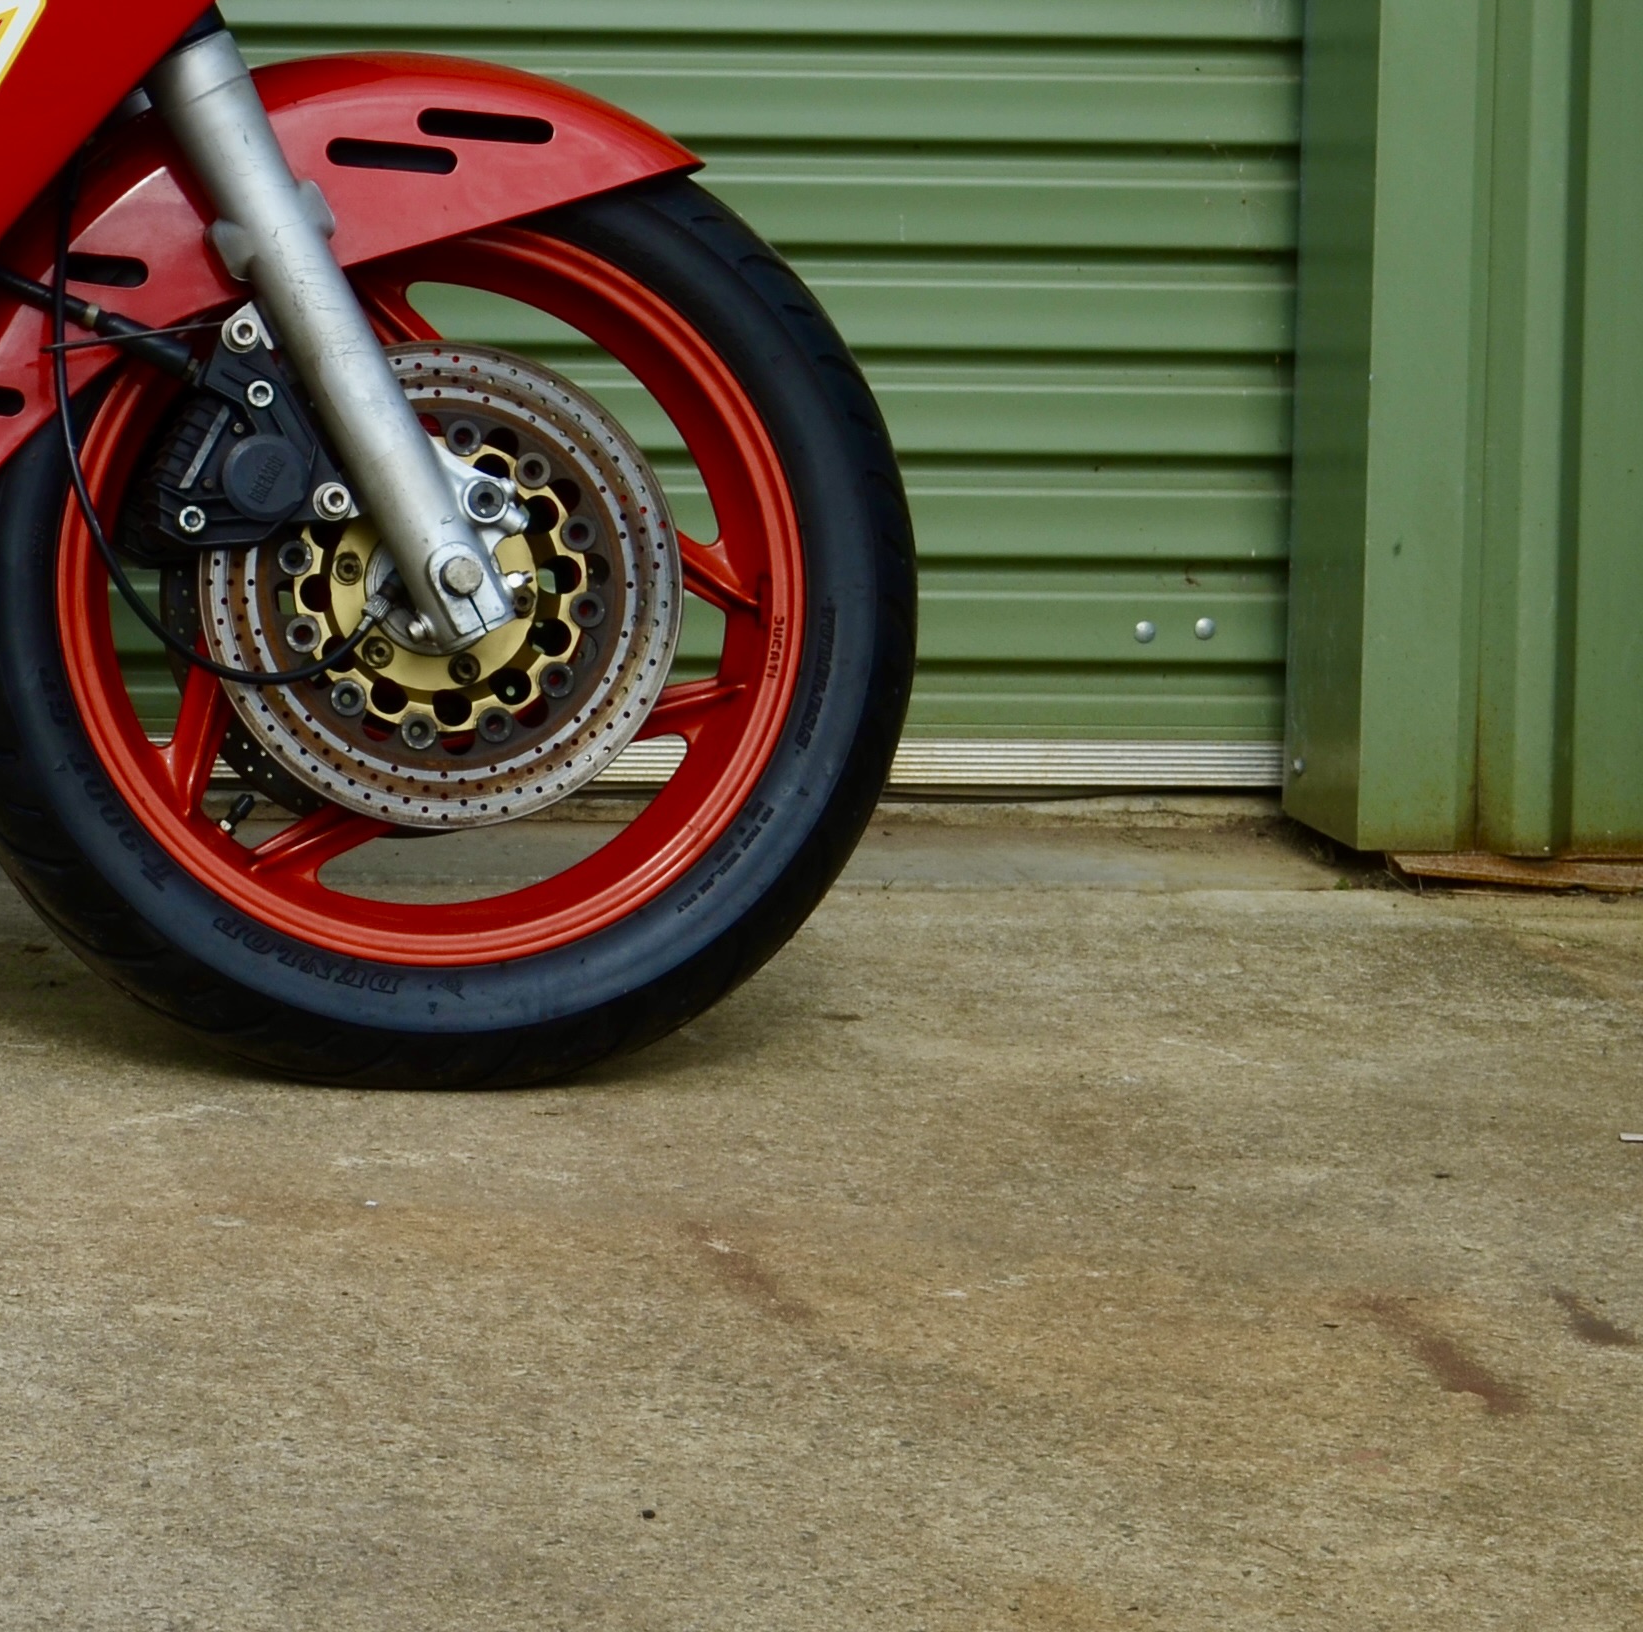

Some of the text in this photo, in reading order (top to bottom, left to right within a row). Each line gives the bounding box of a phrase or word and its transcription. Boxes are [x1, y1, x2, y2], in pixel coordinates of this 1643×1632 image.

[247, 454, 286, 505] BREMBO
[766, 615, 786, 680] DUCATI
[211, 913, 400, 994] DUNLOP
